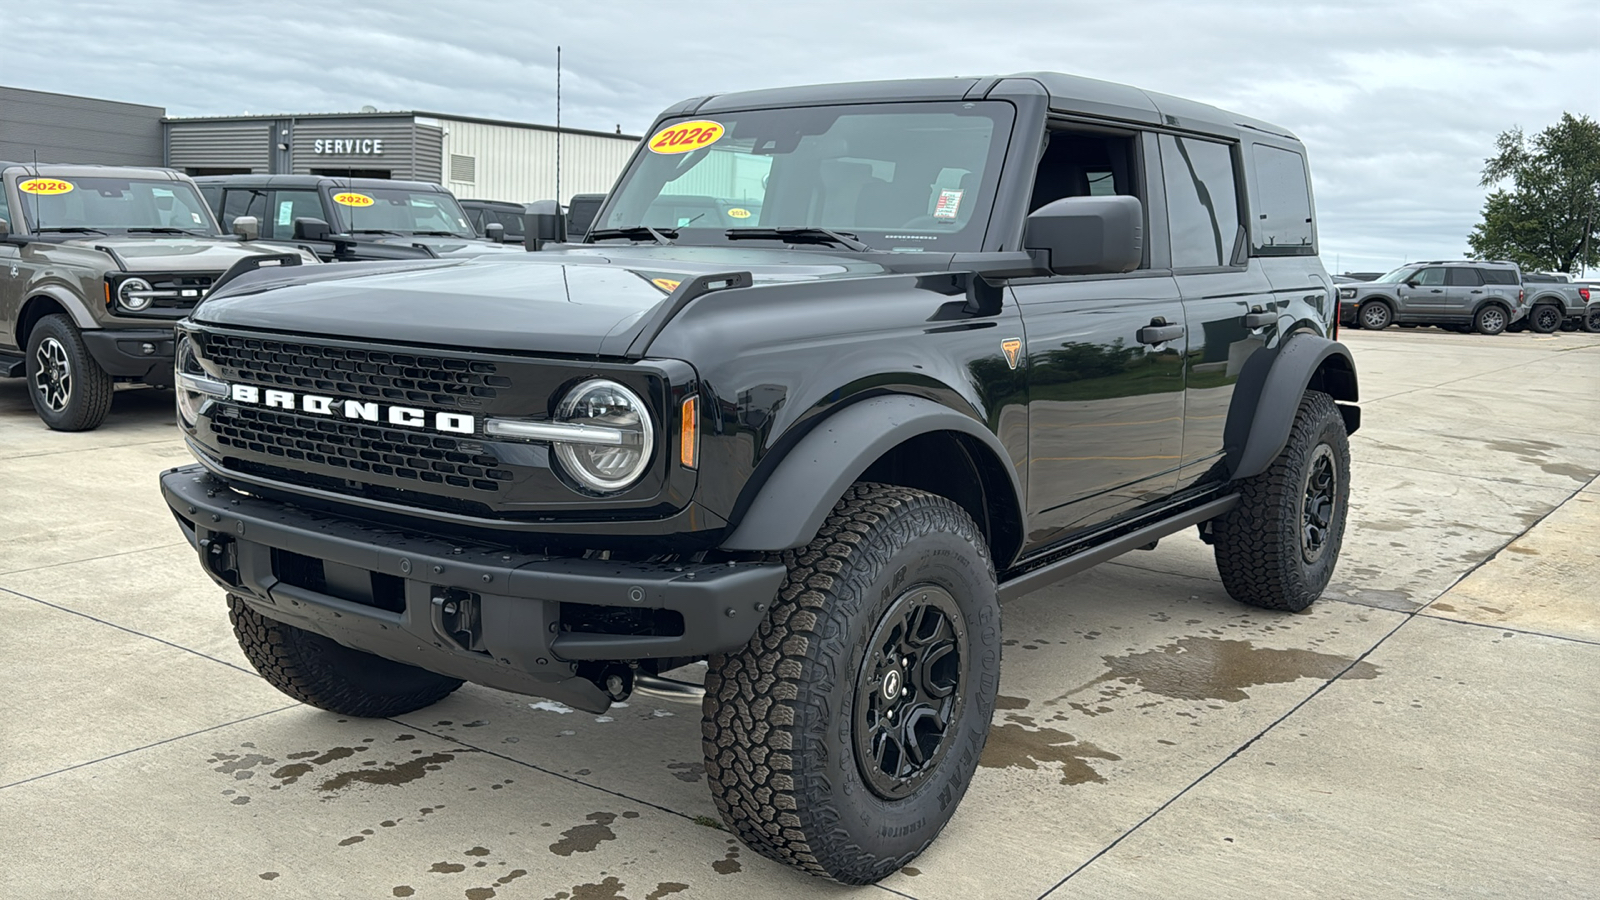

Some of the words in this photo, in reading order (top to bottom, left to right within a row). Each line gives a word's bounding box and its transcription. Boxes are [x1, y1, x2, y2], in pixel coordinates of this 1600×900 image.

[653, 127, 718, 148] 2026
[314, 139, 382, 154] SERVICE
[27, 182, 67, 191] 2026
[339, 195, 369, 204] 2026
[232, 384, 475, 434] BRONCO
